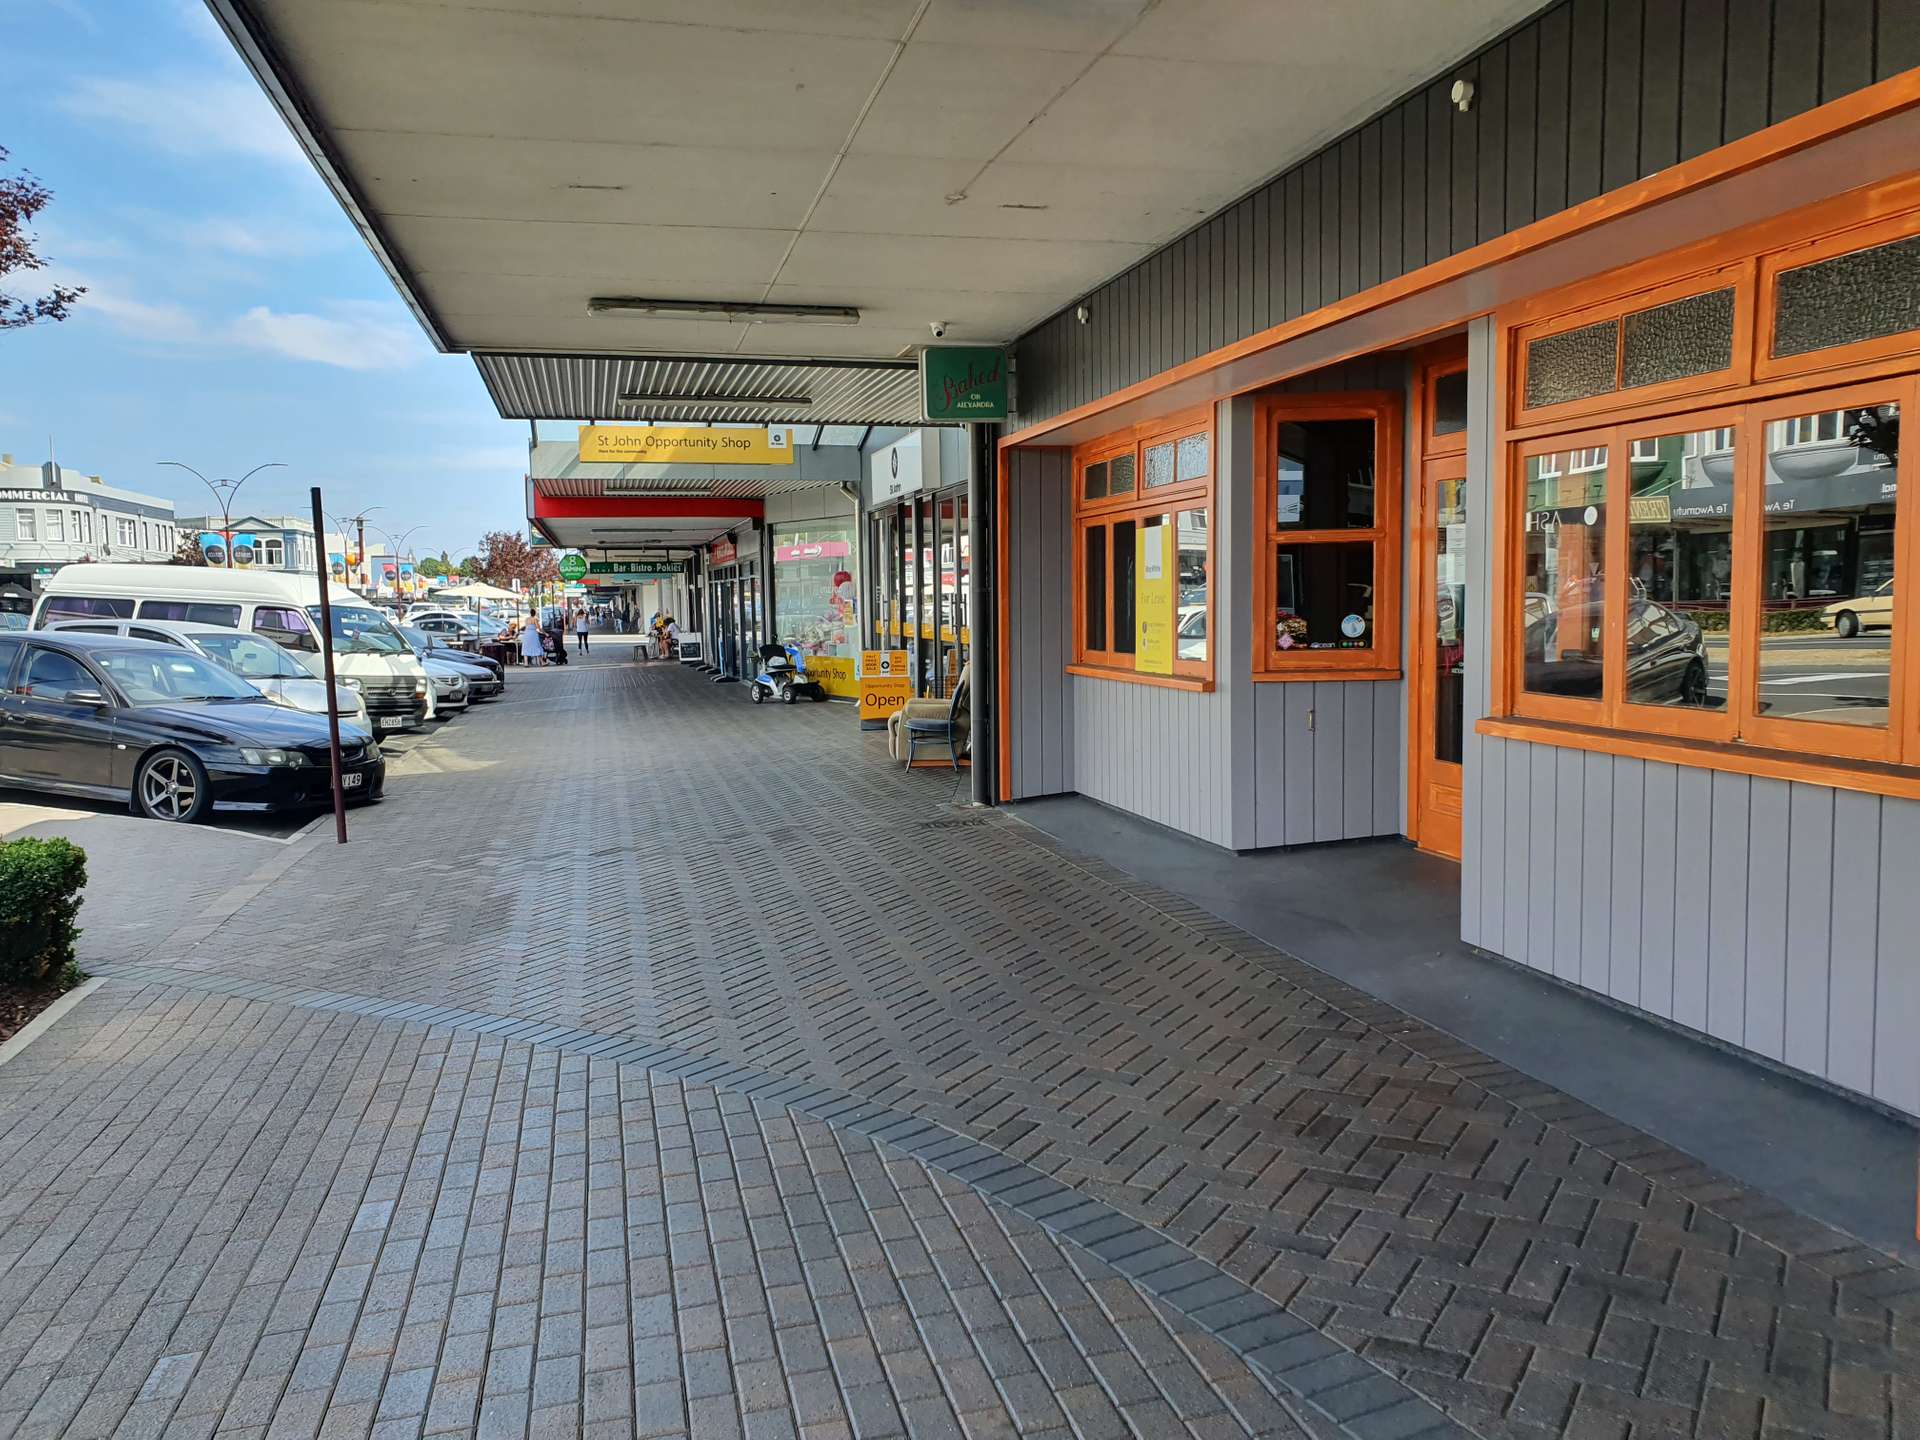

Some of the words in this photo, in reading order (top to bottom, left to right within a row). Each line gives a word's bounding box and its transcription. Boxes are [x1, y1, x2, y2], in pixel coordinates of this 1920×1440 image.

[598, 436, 609, 447] St
[613, 435, 641, 447] John
[645, 436, 718, 450] Opportunity
[721, 437, 751, 451] Shop
[0, 490, 70, 501] MMERCIAL
[613, 563, 626, 572] Bar
[630, 563, 652, 572] Bistro
[656, 563, 681, 572] Pokies
[832, 668, 846, 680] Shop
[865, 693, 905, 709] Open
